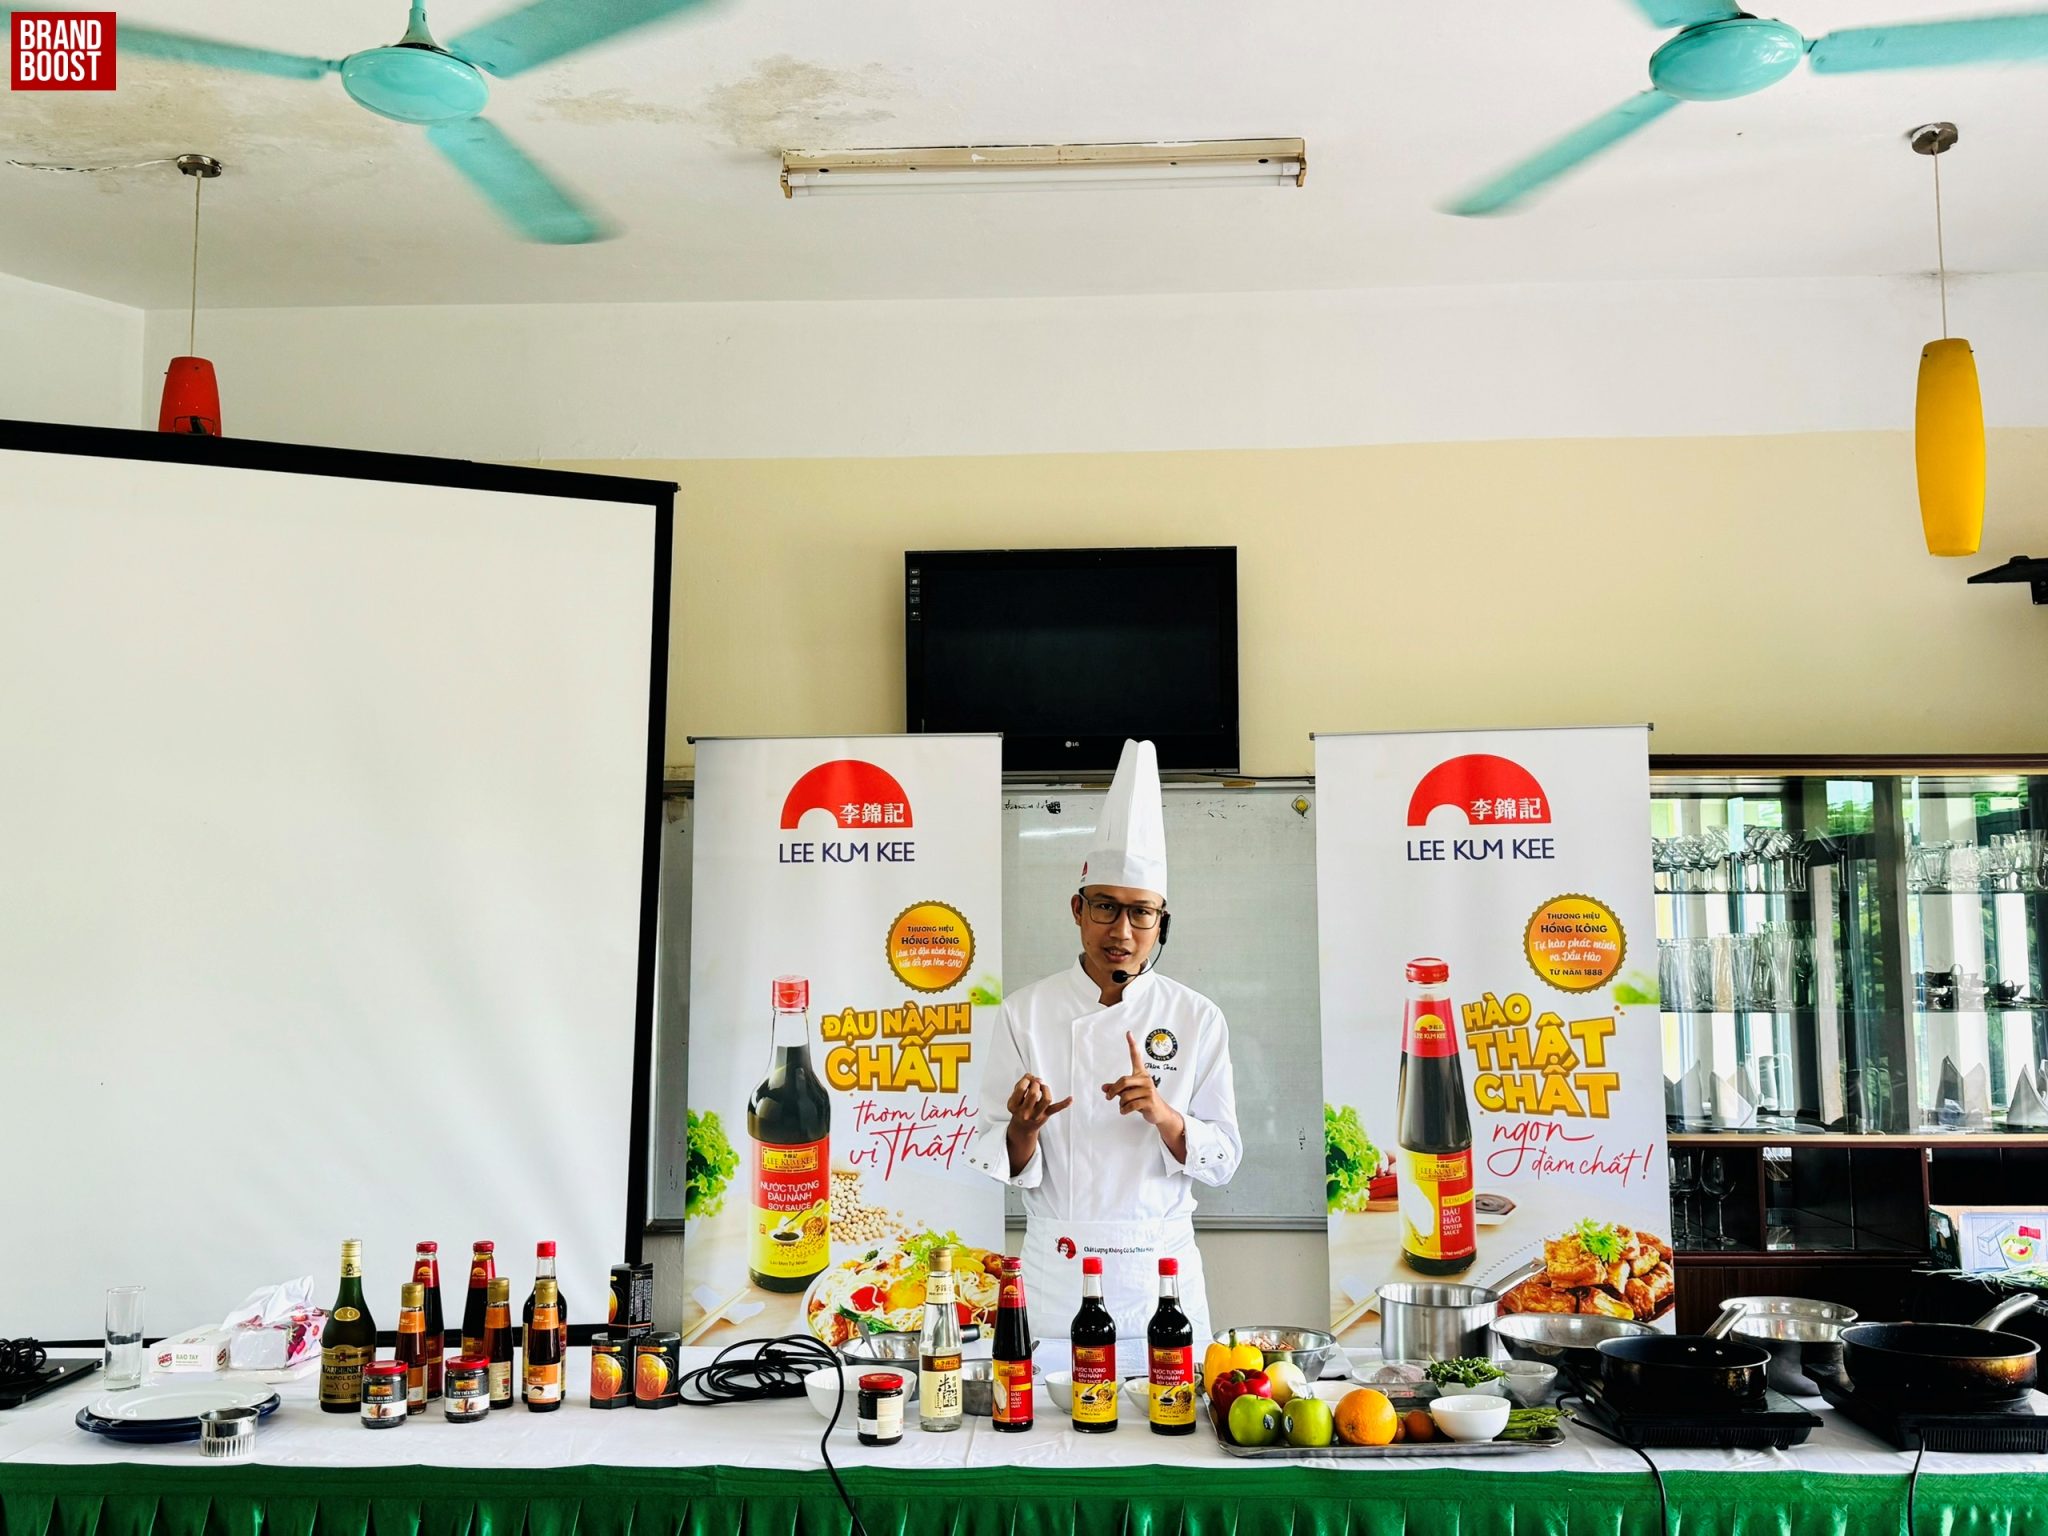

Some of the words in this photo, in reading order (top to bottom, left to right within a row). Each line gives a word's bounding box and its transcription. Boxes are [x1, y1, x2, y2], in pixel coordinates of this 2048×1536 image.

[839, 802, 905, 824] 李錦記
[1470, 797, 1542, 821] 李錦記
[779, 843, 815, 863] LEE
[822, 842, 868, 863] KUM
[877, 841, 915, 862] KEE
[1407, 840, 1445, 861] LEE
[1453, 839, 1503, 860] KUM
[1513, 838, 1555, 859] KEE
[821, 1006, 877, 1046] ĐẬU
[881, 1000, 972, 1038] NÀNH
[1461, 991, 1532, 1032] HÀO
[1466, 1011, 1616, 1071] THẬT
[826, 1024, 971, 1093] CHẤT
[1474, 1054, 1620, 1118] CHẤT
[921, 1095, 979, 1121] lành
[850, 1140, 878, 1168] vị
[1487, 1120, 1594, 1177] ngon
[1531, 1146, 1575, 1180] đậm
[768, 1202, 784, 1211] SOY
[785, 1201, 811, 1211] SAUCE
